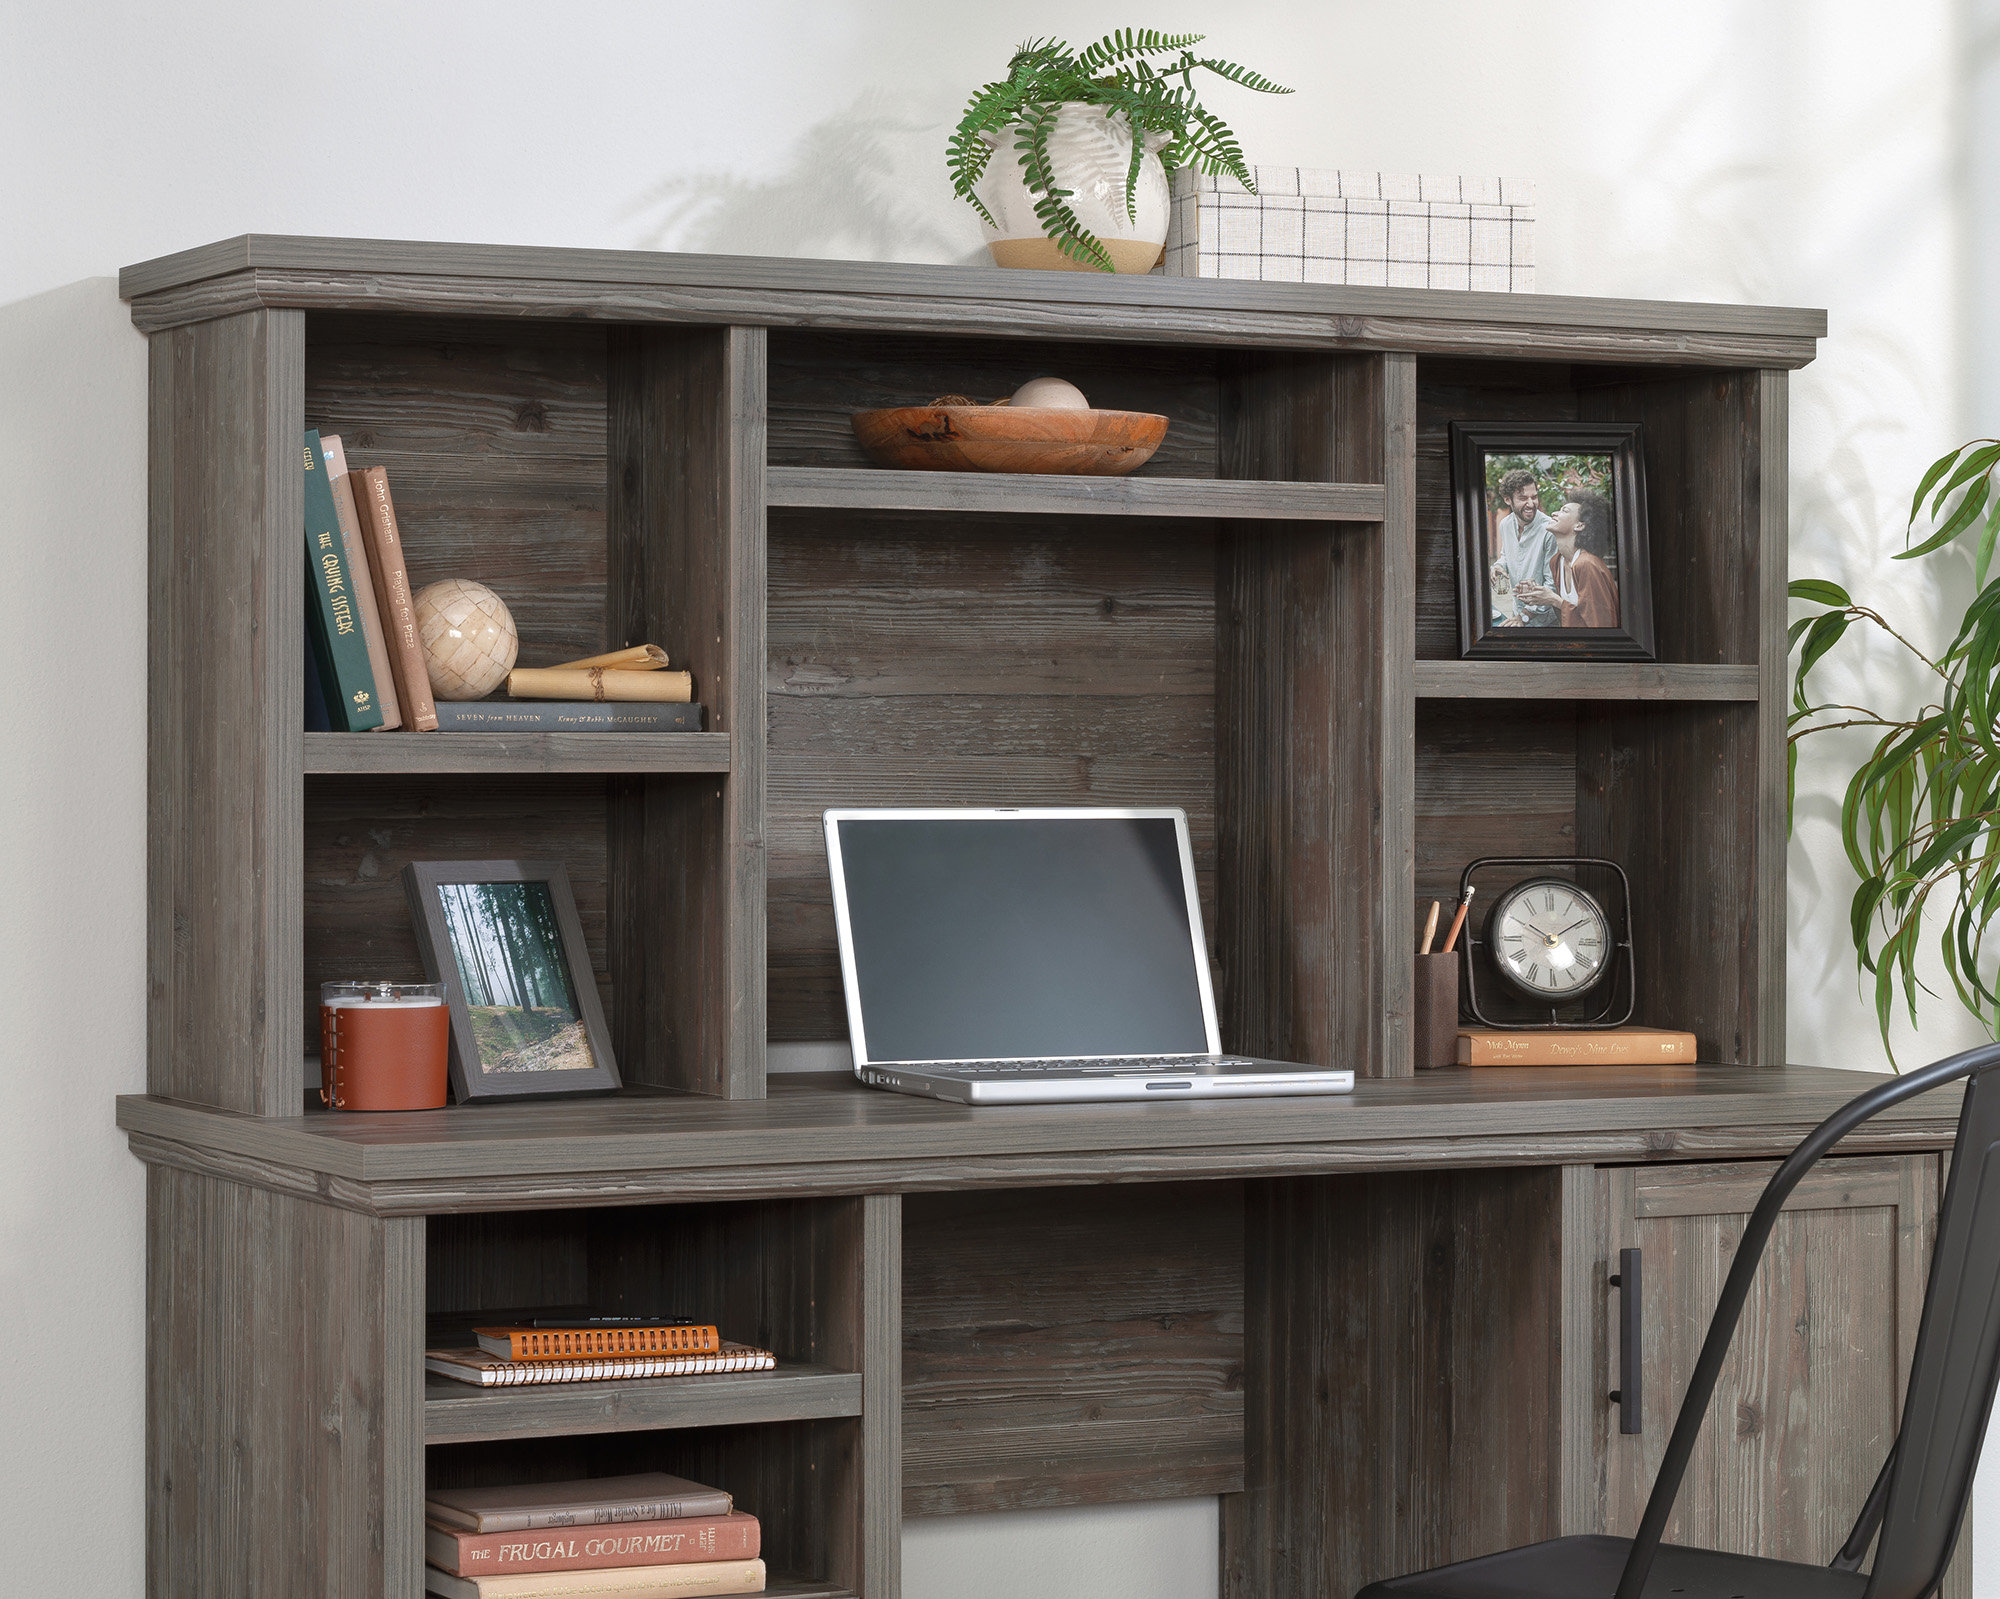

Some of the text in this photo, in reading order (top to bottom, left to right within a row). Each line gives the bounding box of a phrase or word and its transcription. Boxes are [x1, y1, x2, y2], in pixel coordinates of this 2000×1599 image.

[374, 478, 394, 544] John Grisham
[318, 531, 355, 635] THE CRYING SISTERS
[392, 570, 415, 648] Playing for Pizza
[485, 714, 503, 723] from
[557, 716, 578, 724] Kenny
[1550, 1042, 1630, 1057] Dewey's Nine Lives
[594, 1507, 613, 1523] World
[614, 1505, 639, 1520] Secular
[646, 1503, 656, 1519] for
[659, 1502, 682, 1518] FAITH
[471, 1534, 685, 1562] THE FRUGAL GOURMET
[708, 1527, 716, 1554] SMITH
